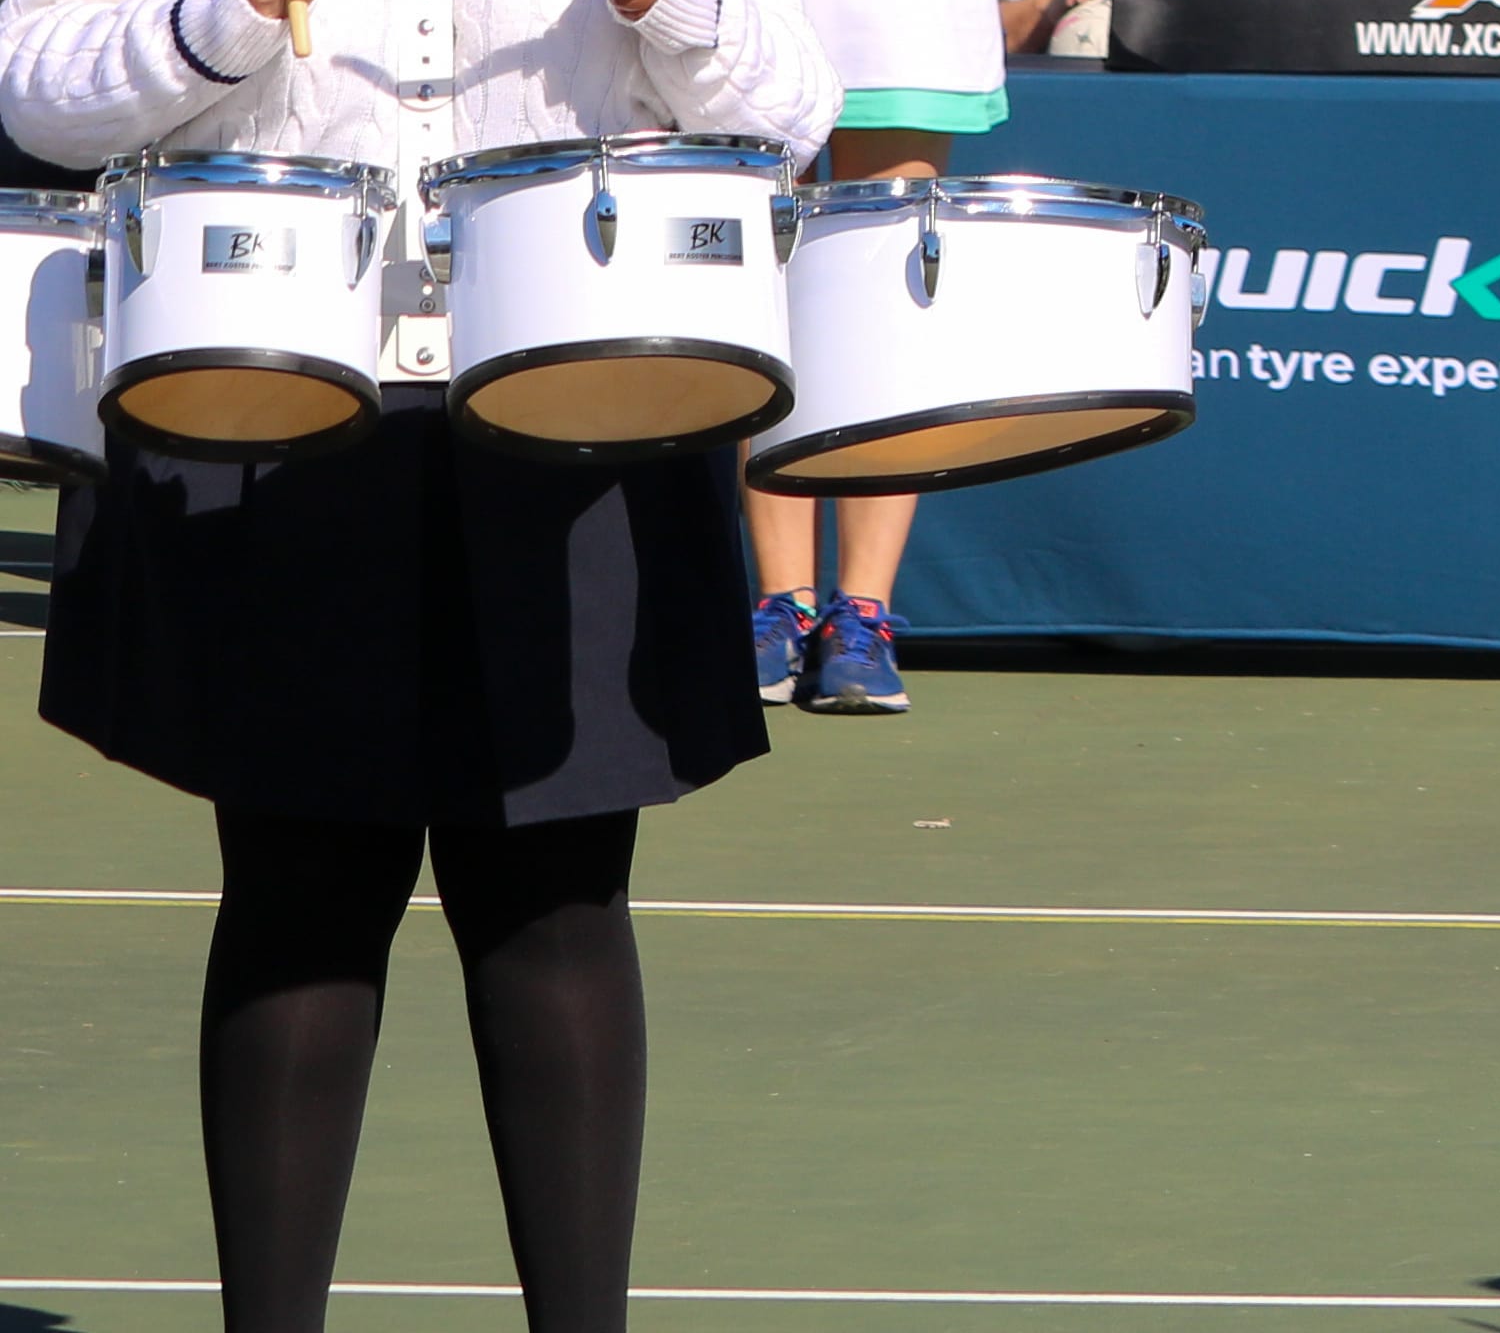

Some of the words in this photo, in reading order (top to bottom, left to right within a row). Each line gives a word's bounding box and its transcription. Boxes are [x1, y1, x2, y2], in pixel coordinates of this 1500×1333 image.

[228, 231, 270, 261] BK
[689, 220, 726, 251] BK
[1246, 343, 1356, 390] tyre
